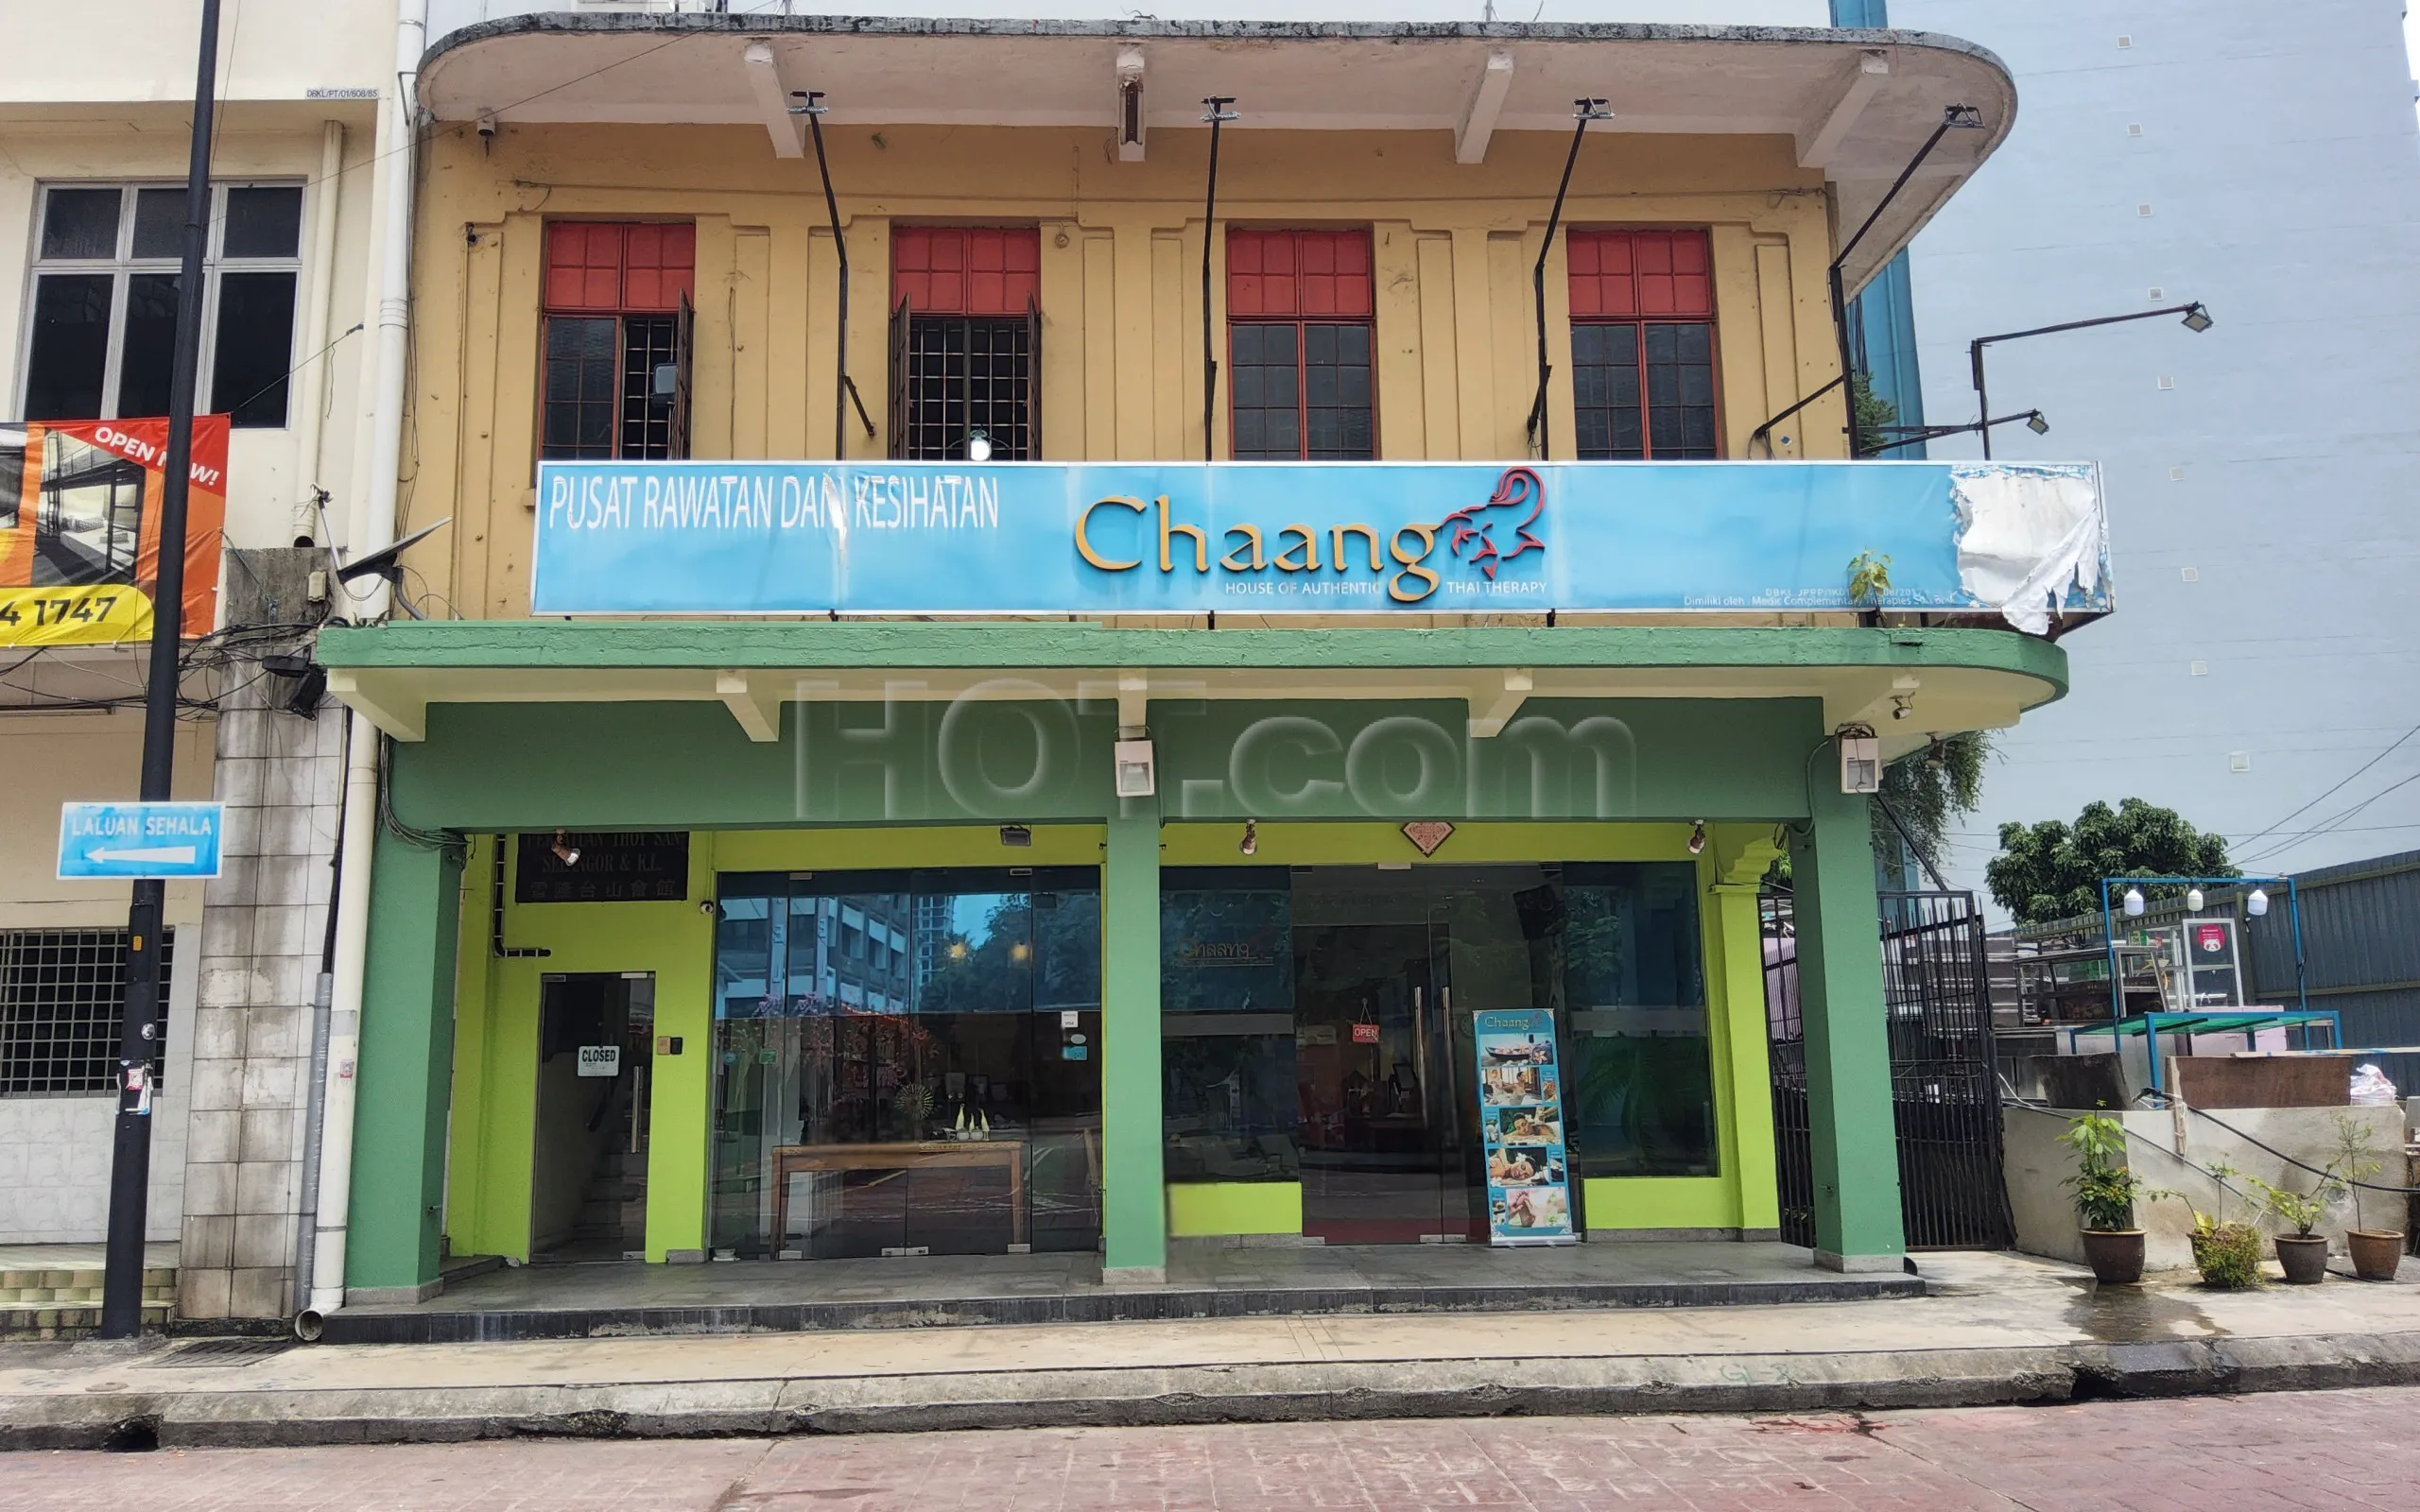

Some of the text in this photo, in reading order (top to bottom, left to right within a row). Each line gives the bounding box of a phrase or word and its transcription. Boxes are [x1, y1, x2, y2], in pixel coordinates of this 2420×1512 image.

[95, 426, 156, 462] OPEN
[548, 475, 999, 530] PUSAT RAWATAN DAN KESIHATAN
[1074, 494, 1443, 602] Chaang
[1225, 581, 1547, 594] HOUSE OF AUTHENTIC THAI THERAPY
[34, 596, 118, 627] 1747
[71, 816, 213, 836] LALUAN SEHALA
[619, 853, 631, 872] &
[1354, 1027, 1377, 1037] OPEN
[1484, 1015, 1530, 1031] Chaang
[581, 1049, 616, 1063] CLOSED
